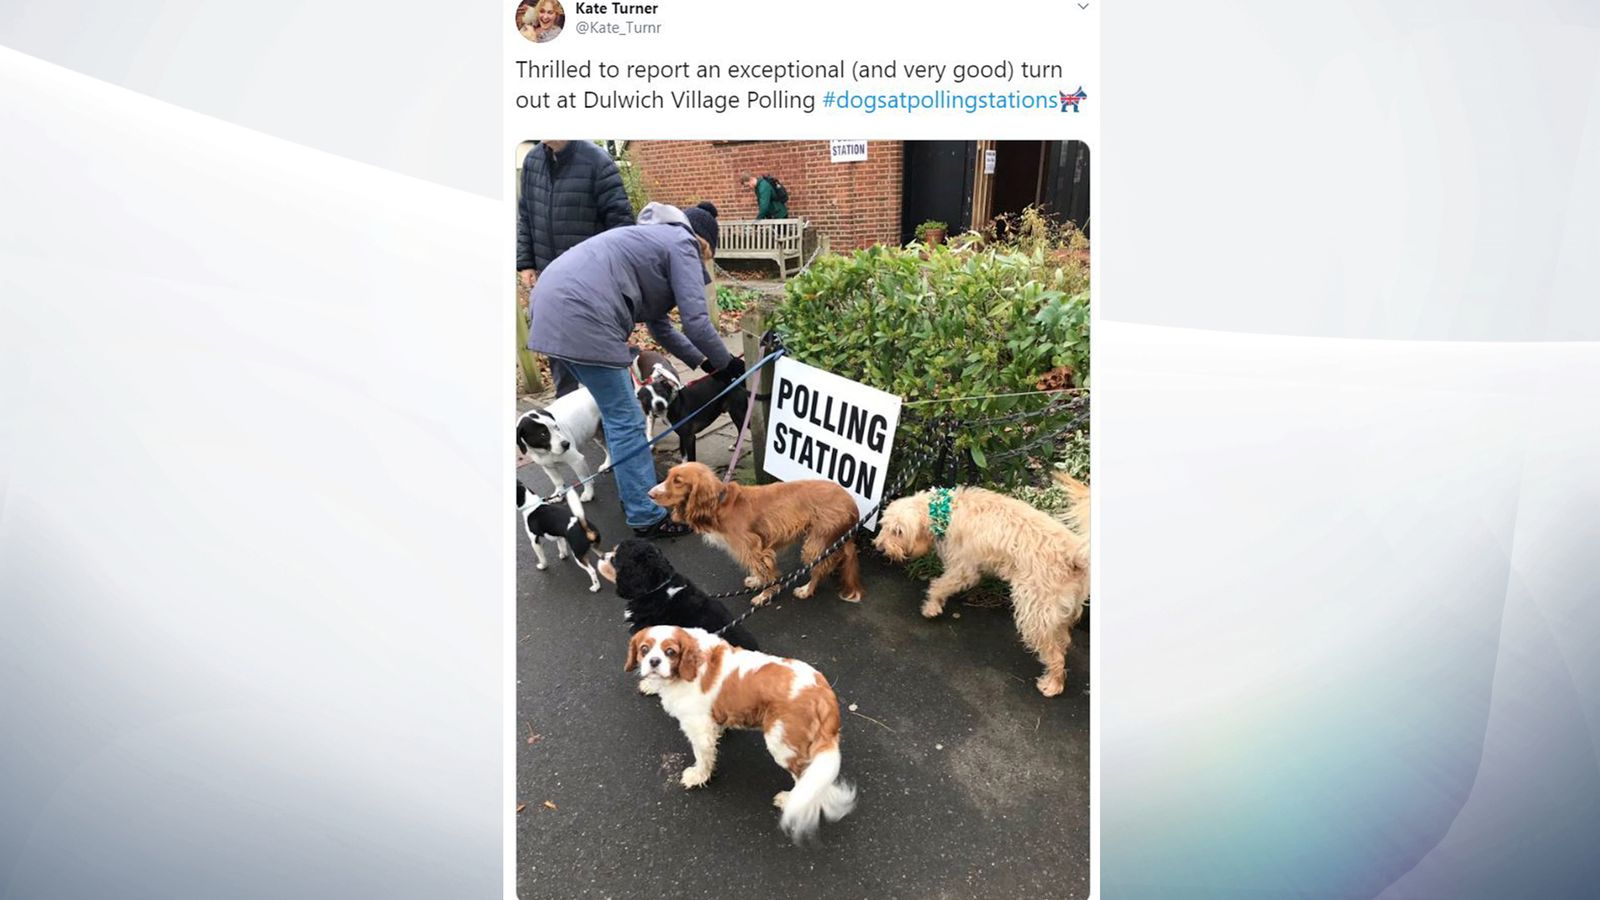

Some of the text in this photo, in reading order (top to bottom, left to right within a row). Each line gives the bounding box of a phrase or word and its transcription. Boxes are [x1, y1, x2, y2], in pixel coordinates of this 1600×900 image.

[832, 144, 865, 156] STATION
[777, 377, 888, 454] POLLING
[773, 422, 877, 500] STATION
